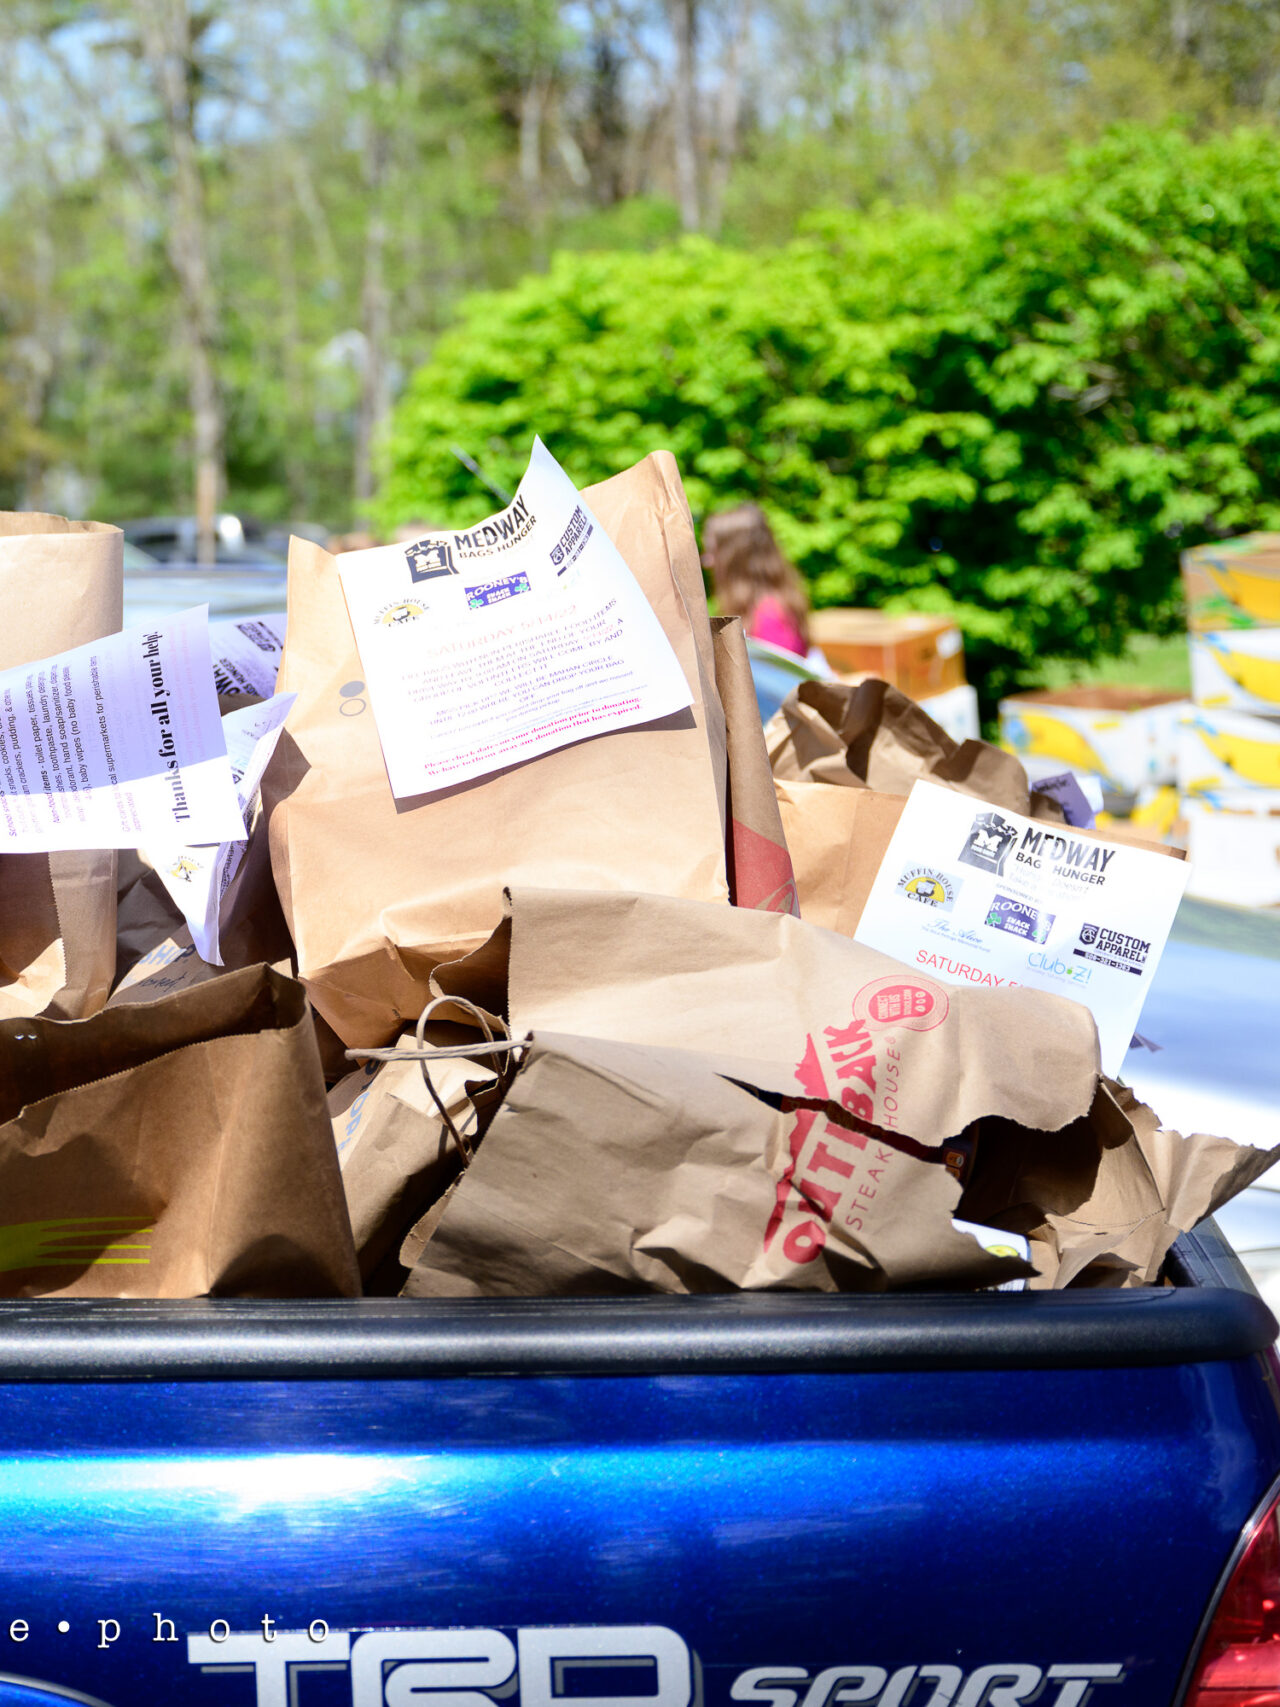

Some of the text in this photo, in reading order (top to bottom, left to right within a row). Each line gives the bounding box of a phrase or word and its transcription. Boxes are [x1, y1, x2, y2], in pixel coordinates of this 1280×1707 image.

[454, 494, 529, 550] MEDWAY
[560, 504, 583, 546] CUSTOM
[459, 550, 493, 559] BAGS
[498, 515, 537, 552] HUNGER
[39, 693, 50, 723] laundry
[66, 697, 77, 719] baby
[95, 701, 104, 714] for
[530, 717, 569, 734] donation
[568, 710, 590, 722] prior
[7, 711, 21, 750] pudding,
[30, 713, 41, 742] paper,
[70, 718, 80, 736] (no
[140, 629, 190, 824] Thanks for all your help!
[534, 723, 572, 740] donation
[572, 717, 590, 727] that
[35, 743, 44, 764] toilet
[45, 724, 60, 772] toothpaste,
[61, 741, 70, 763] hand
[73, 736, 83, 762] wipes
[98, 714, 116, 773] supermarkets
[4, 764, 15, 791] snacks,
[14, 750, 27, 784] crackers,
[40, 769, 51, 791] items
[79, 762, 89, 783] baby
[1020, 827, 1115, 873] MEDWAY
[1016, 852, 1044, 869] BAG
[1053, 865, 1106, 885] HUNGER
[898, 868, 954, 902] MUFFIN HOUSE
[907, 892, 938, 907] CAFE
[1096, 940, 1142, 963] APPAREL
[1099, 928, 1151, 953] CUSTOM
[916, 950, 1005, 987] SATURDAY
[783, 1019, 877, 1264] OUTBACK
[188, 1626, 1124, 1707] TRD SPORT
